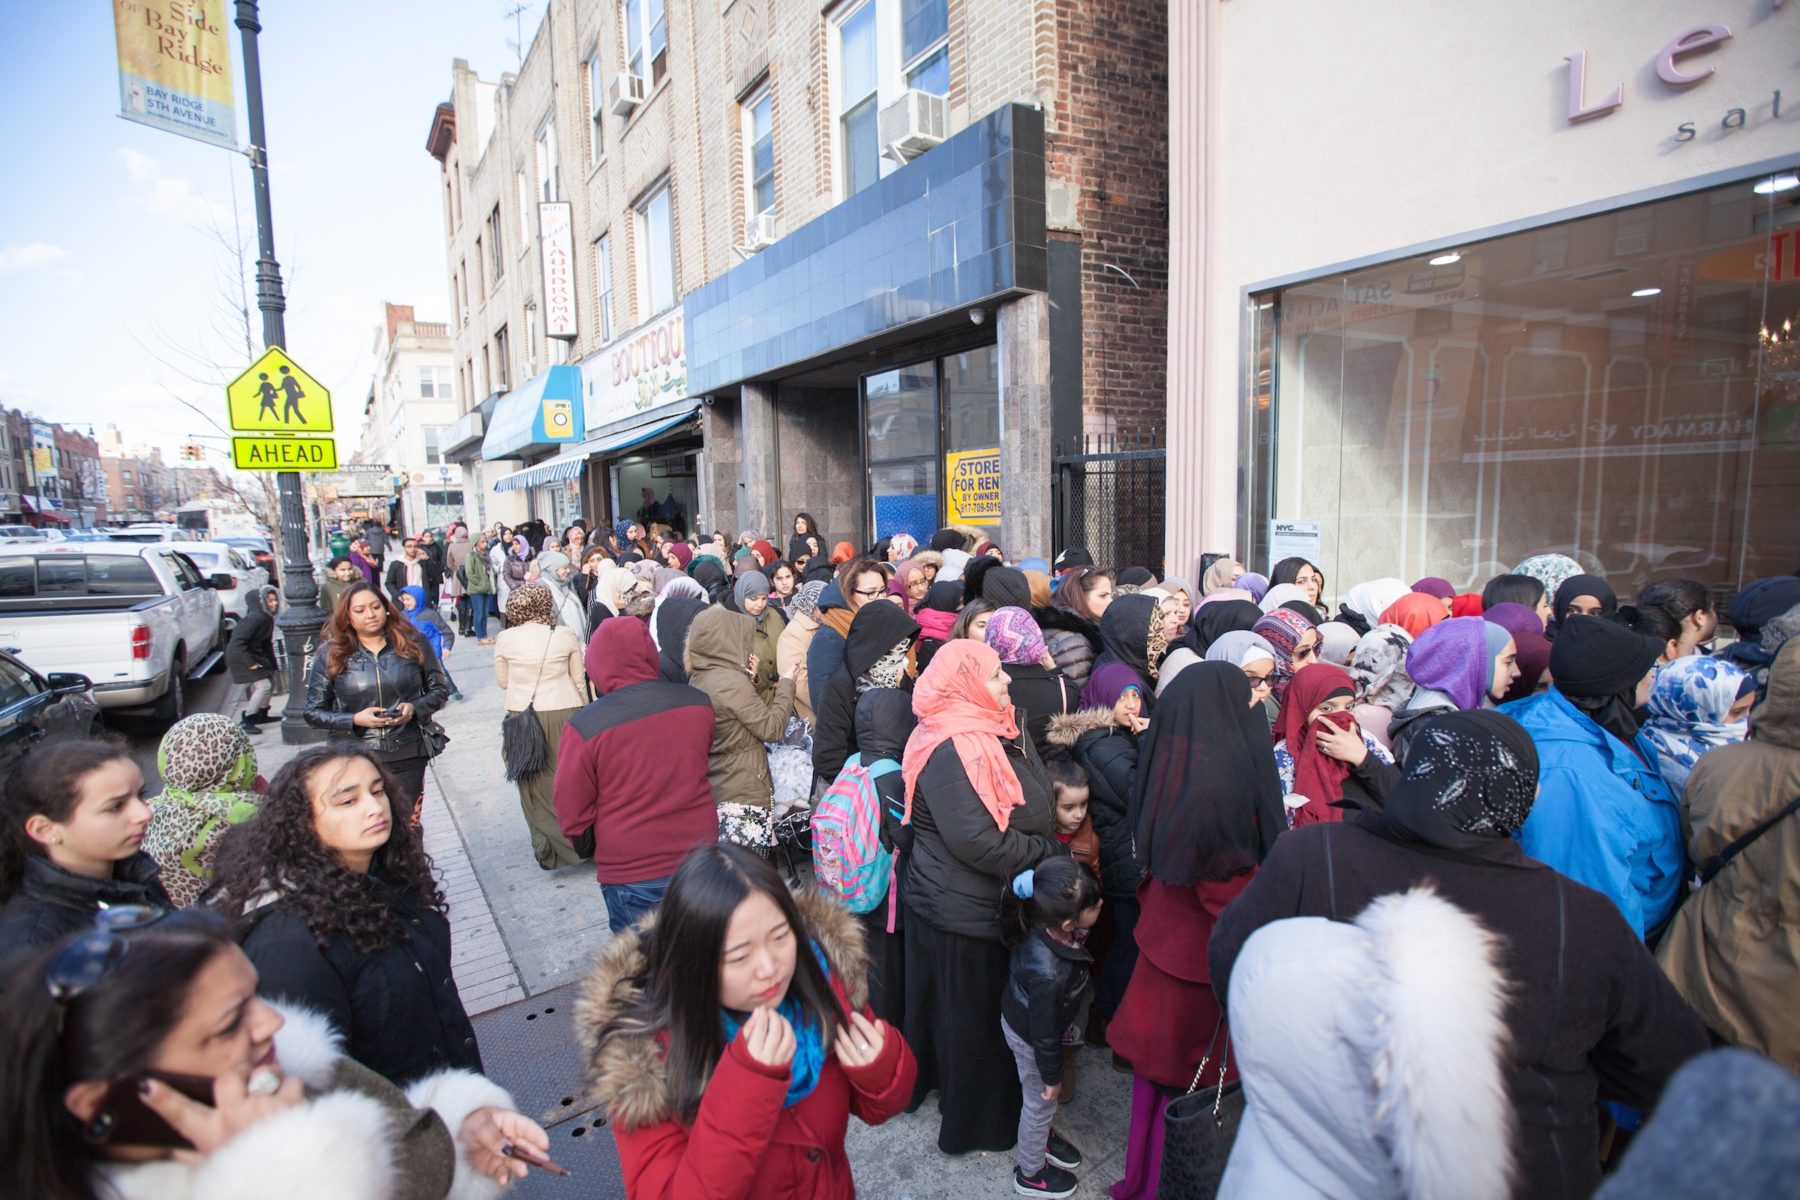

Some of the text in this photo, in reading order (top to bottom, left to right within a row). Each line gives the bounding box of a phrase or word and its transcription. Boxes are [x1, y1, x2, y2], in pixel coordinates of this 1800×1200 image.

[145, 7, 187, 43] Bay
[170, 2, 219, 35] Side
[158, 36, 223, 75] Ridge
[1563, 0, 1786, 125] Le
[146, 86, 205, 112] BAY RIDGE
[147, 98, 170, 112] 5TH
[173, 107, 217, 127] AVENUE
[550, 239, 570, 333] LAUNDROMAT
[249, 444, 323, 463] AHEAD
[960, 459, 1000, 476] STORE
[955, 476, 1000, 492] FOR REN
[962, 492, 999, 502] BY OWNER
